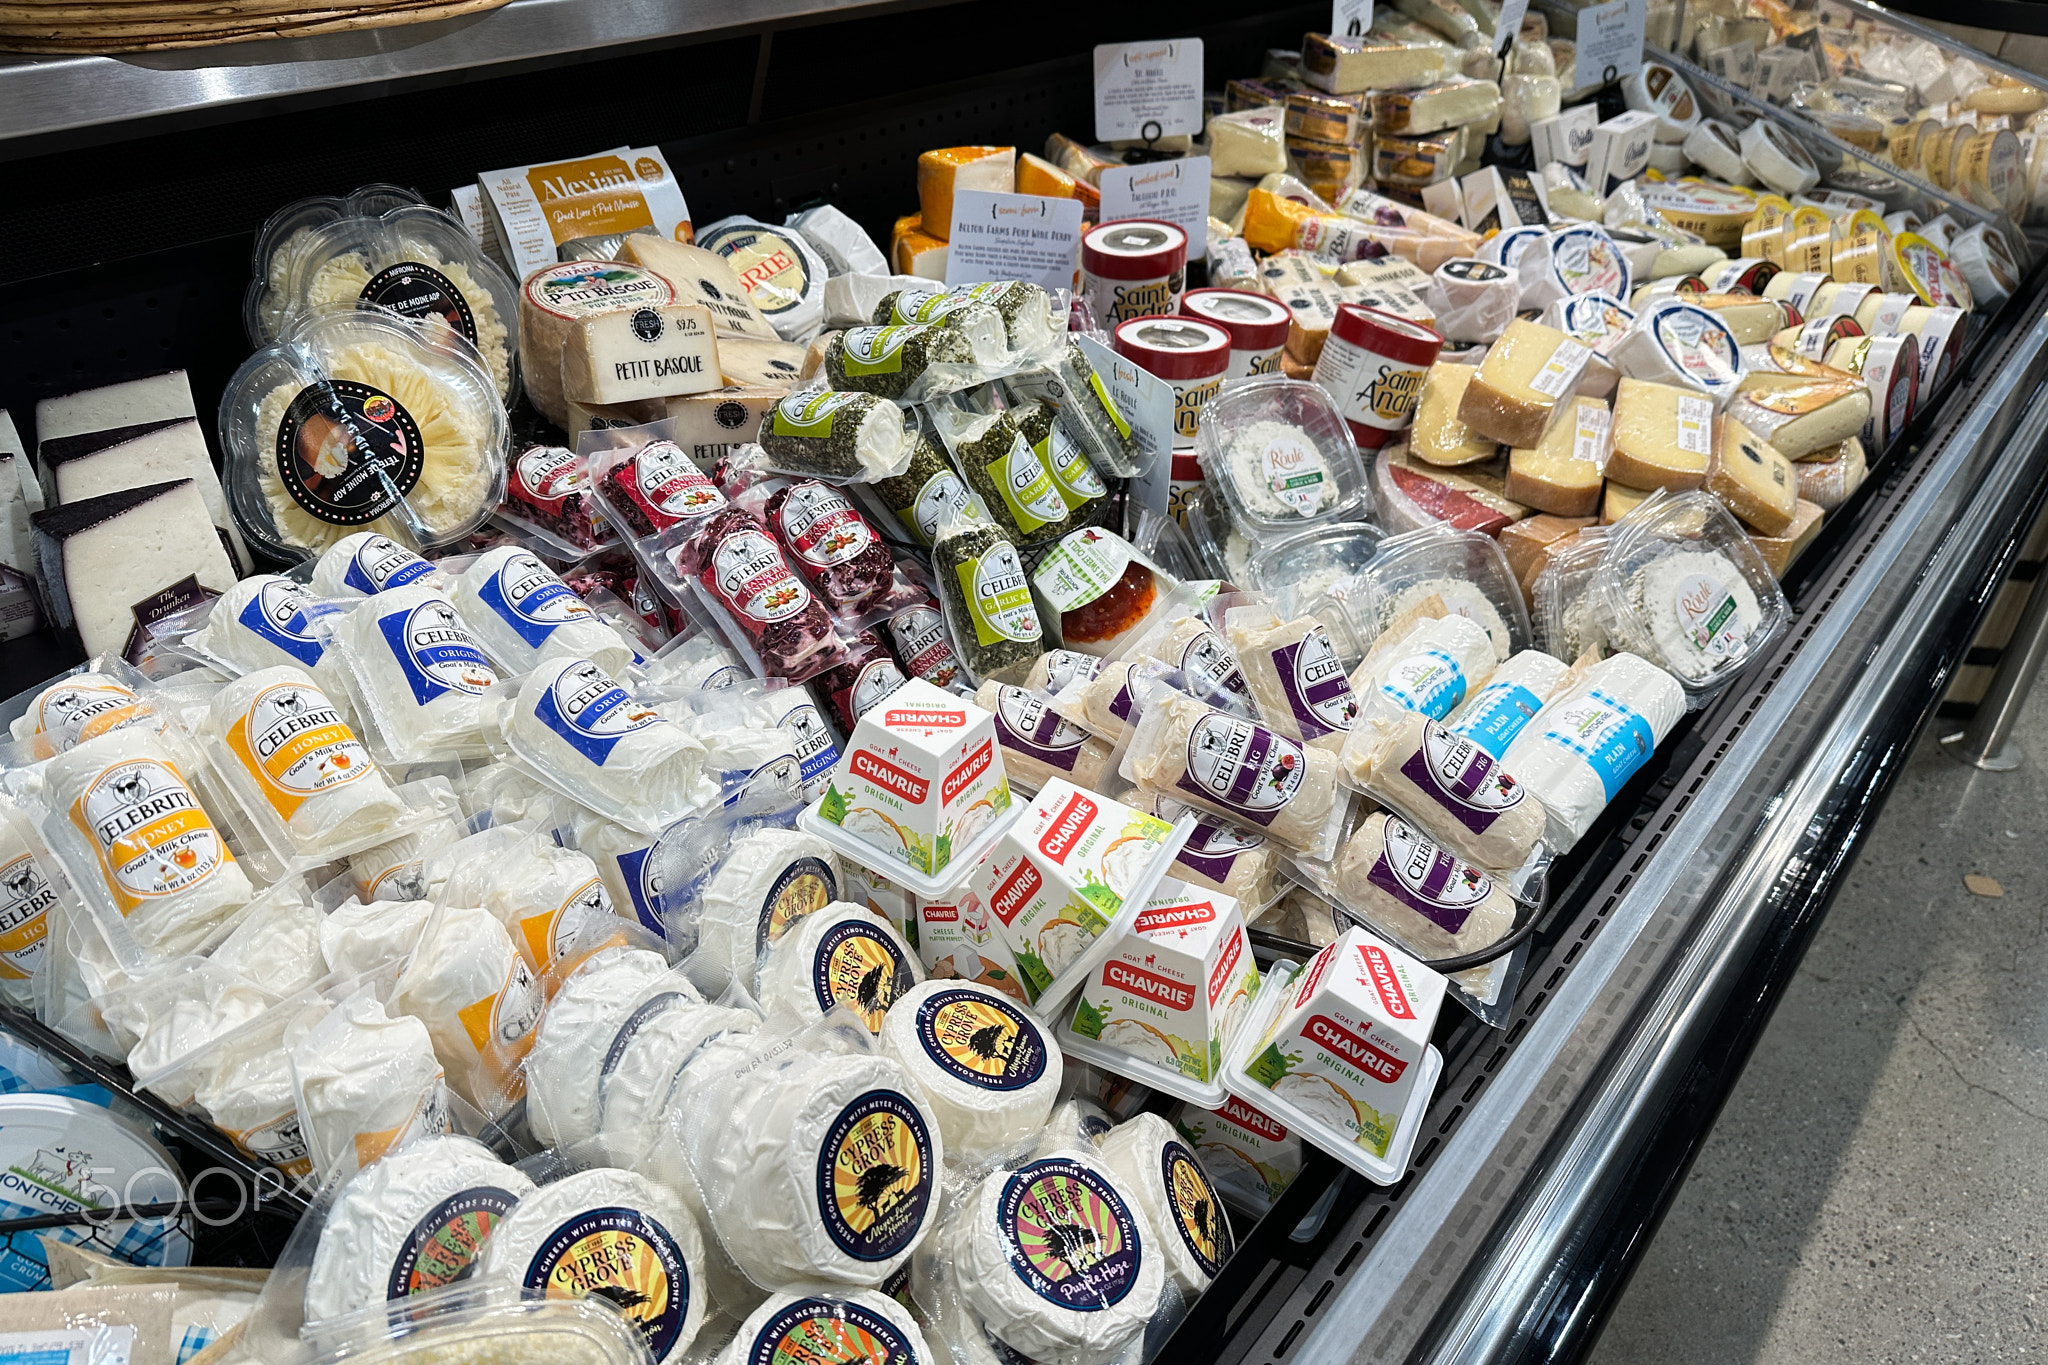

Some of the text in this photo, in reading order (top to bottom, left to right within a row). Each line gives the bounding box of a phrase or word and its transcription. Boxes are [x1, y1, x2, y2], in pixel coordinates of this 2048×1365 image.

[497, 183, 522, 193] Natural
[542, 171, 631, 201] Alexian
[552, 210, 574, 224] Duck
[576, 205, 592, 220] Liver
[598, 201, 613, 216] Pork
[614, 200, 640, 212] Mousse
[553, 264, 601, 278] ISTARA
[398, 301, 409, 310] DE
[410, 294, 430, 307] MOINE
[592, 280, 657, 296] BASQUE
[1114, 285, 1167, 306] Saint
[634, 319, 660, 330] FRESH
[615, 356, 704, 380] PETIT BASQUE
[1356, 379, 1414, 412] Andr
[694, 443, 730, 459] PETIT
[1268, 446, 1304, 470] Roulé
[788, 498, 852, 539] CELEBRITY
[804, 510, 850, 542] CRANBERRY
[1066, 539, 1111, 585] THAI SWEET CHILI
[149, 592, 190, 618] Drunken
[158, 590, 176, 604] The
[1682, 580, 1713, 621] Roulé
[1413, 668, 1446, 696] MONTCHEVRE
[258, 688, 286, 708] FAMOUSLY
[600, 706, 624, 726] Goat's
[890, 712, 962, 723] CHAVRIE
[1486, 714, 1510, 736] PLAIN
[1508, 715, 1524, 730] CHEESE
[1579, 710, 1614, 740] MONTCHEVRE
[292, 730, 340, 754] HONEY
[968, 736, 986, 752] CHEESE
[1604, 742, 1626, 765] PLAIN
[288, 756, 314, 777] Goat's
[869, 742, 922, 774] GOAT CHEESE
[1474, 756, 1488, 772] FIG
[95, 768, 128, 794] FAMOUSLY
[314, 776, 336, 790] Net Wt
[856, 756, 922, 799] CHAVRIE
[944, 751, 990, 796] CHAVRIE
[1252, 754, 1274, 800] Goat's Milk
[1478, 777, 1492, 796] Goat's
[864, 784, 904, 812] ORIGINAL
[956, 780, 984, 808] ORIGINAL
[100, 792, 198, 846] CELEBRITY
[1032, 793, 1068, 836] GOAT CHEESE
[1044, 800, 1093, 856] CHAVRIE
[131, 818, 186, 850] HONEY
[1076, 824, 1106, 860] ORIGINAL
[124, 831, 209, 876] Goat's Milk Cheese
[152, 879, 180, 892] Net Wt
[986, 855, 1018, 892] GOAT CHEESE
[784, 896, 815, 919] GROVE
[996, 869, 1038, 916] CHAVRIE
[925, 908, 958, 918] CHAVRIE
[1020, 898, 1046, 928] ORIGINAL
[1140, 907, 1211, 926] CHAVRIE
[932, 928, 954, 936] CHEESE
[14, 941, 45, 960] Goat's
[818, 936, 898, 1006] CHEESE HONEY
[834, 941, 856, 1002] CYPRESS
[848, 952, 864, 999] GROVE
[1122, 952, 1186, 980] GOAT CHEESE
[1210, 937, 1241, 998] CHAVRIE
[1353, 954, 1380, 1006] GOAT CHEESE
[1110, 966, 1188, 1006] CHAVRIE
[1219, 971, 1238, 1006] ORIGINAL
[1368, 948, 1406, 1016] CHAVRIE
[1396, 964, 1420, 1003] ORIGINAL
[1122, 996, 1170, 1020] ORIGINAL
[941, 1002, 968, 1046] CYPRESS
[956, 1010, 978, 1046] GROVE
[1334, 1011, 1401, 1054] GOAT CHEESE
[924, 1006, 1024, 1078] GOAT MILK CHEESE HONEY
[1312, 1020, 1398, 1078] CHAVRIE
[1316, 1051, 1366, 1088] ORIGINAL
[848, 1106, 867, 1123] WITH
[869, 1100, 892, 1110] MEYER
[894, 1103, 915, 1125] LEMON
[828, 1122, 848, 1158] CHEESE
[840, 1114, 896, 1167] CYPRESS
[914, 1126, 924, 1143] AND
[1215, 1120, 1262, 1149] ORIGINAL
[852, 1134, 895, 1175] GROVE
[824, 1164, 832, 1188] MILK
[827, 1194, 838, 1220] GOAT
[1006, 1166, 1133, 1251] CHEESE LAVENDER AND FENNEL POLLEN
[1022, 1182, 1084, 1219] CYPRESS
[1036, 1202, 1084, 1229] GROVE
[396, 1198, 477, 1292] CHEESE WITH HERBS
[556, 1236, 636, 1284] CYPRESS
[540, 1218, 680, 1310] CHEESE WITH MEYER HONEY
[1060, 1260, 1130, 1300] Purple Haze
[770, 1312, 898, 1349] WITH PROVENCE
